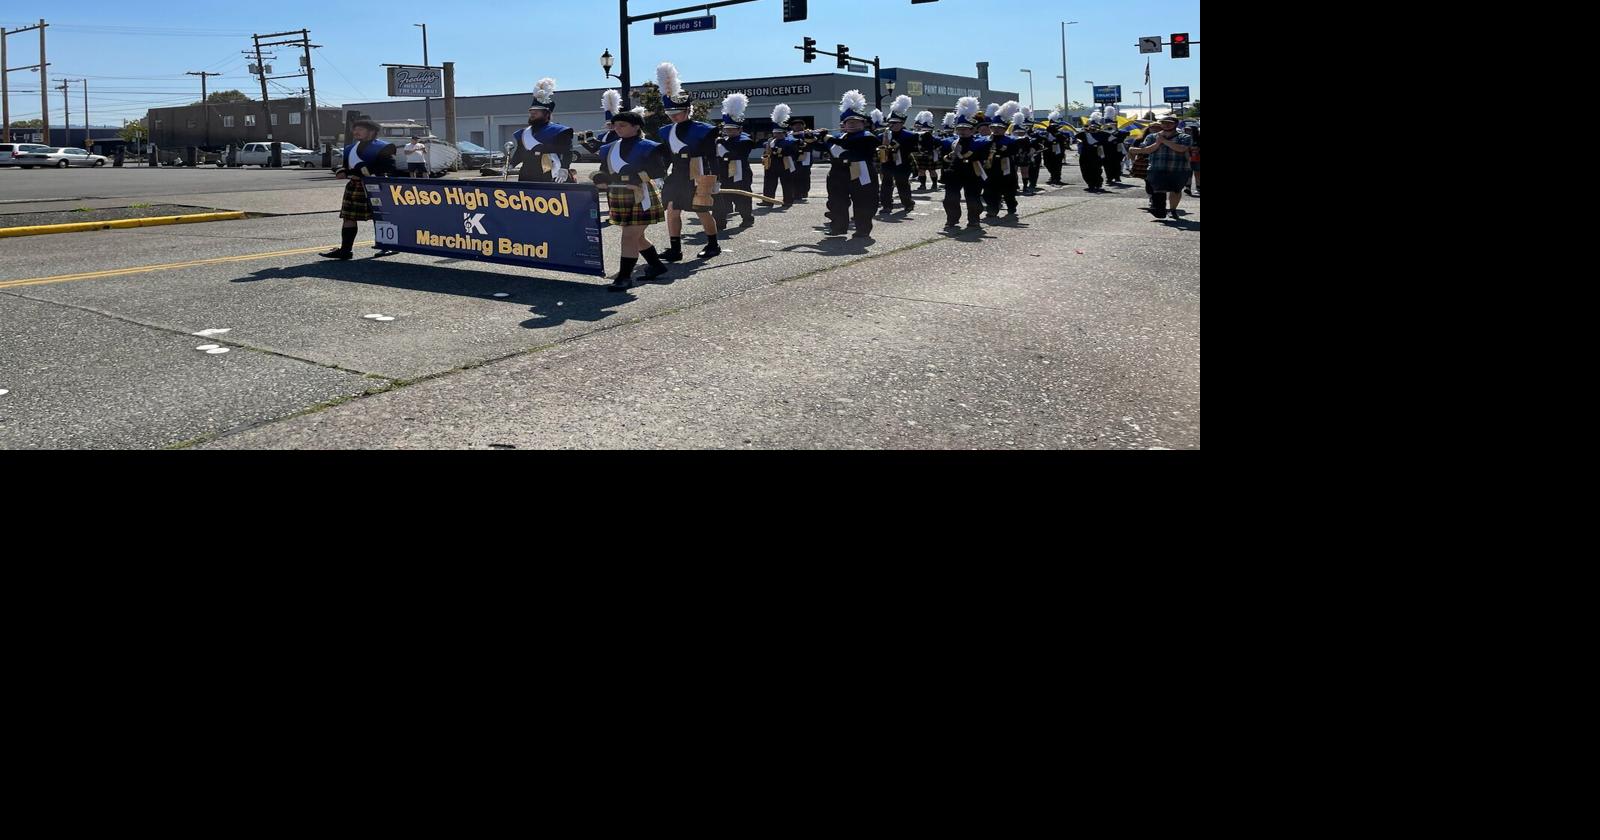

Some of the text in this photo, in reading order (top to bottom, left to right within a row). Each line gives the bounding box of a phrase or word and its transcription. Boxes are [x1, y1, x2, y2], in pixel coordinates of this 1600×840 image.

[664, 20, 702, 31] Florida St
[700, 91, 719, 99] AND
[721, 87, 769, 98] COISION
[772, 85, 811, 94] CENTER
[390, 185, 570, 218] Kelso High School
[378, 226, 395, 240] 10
[416, 229, 549, 259] Marching Band
